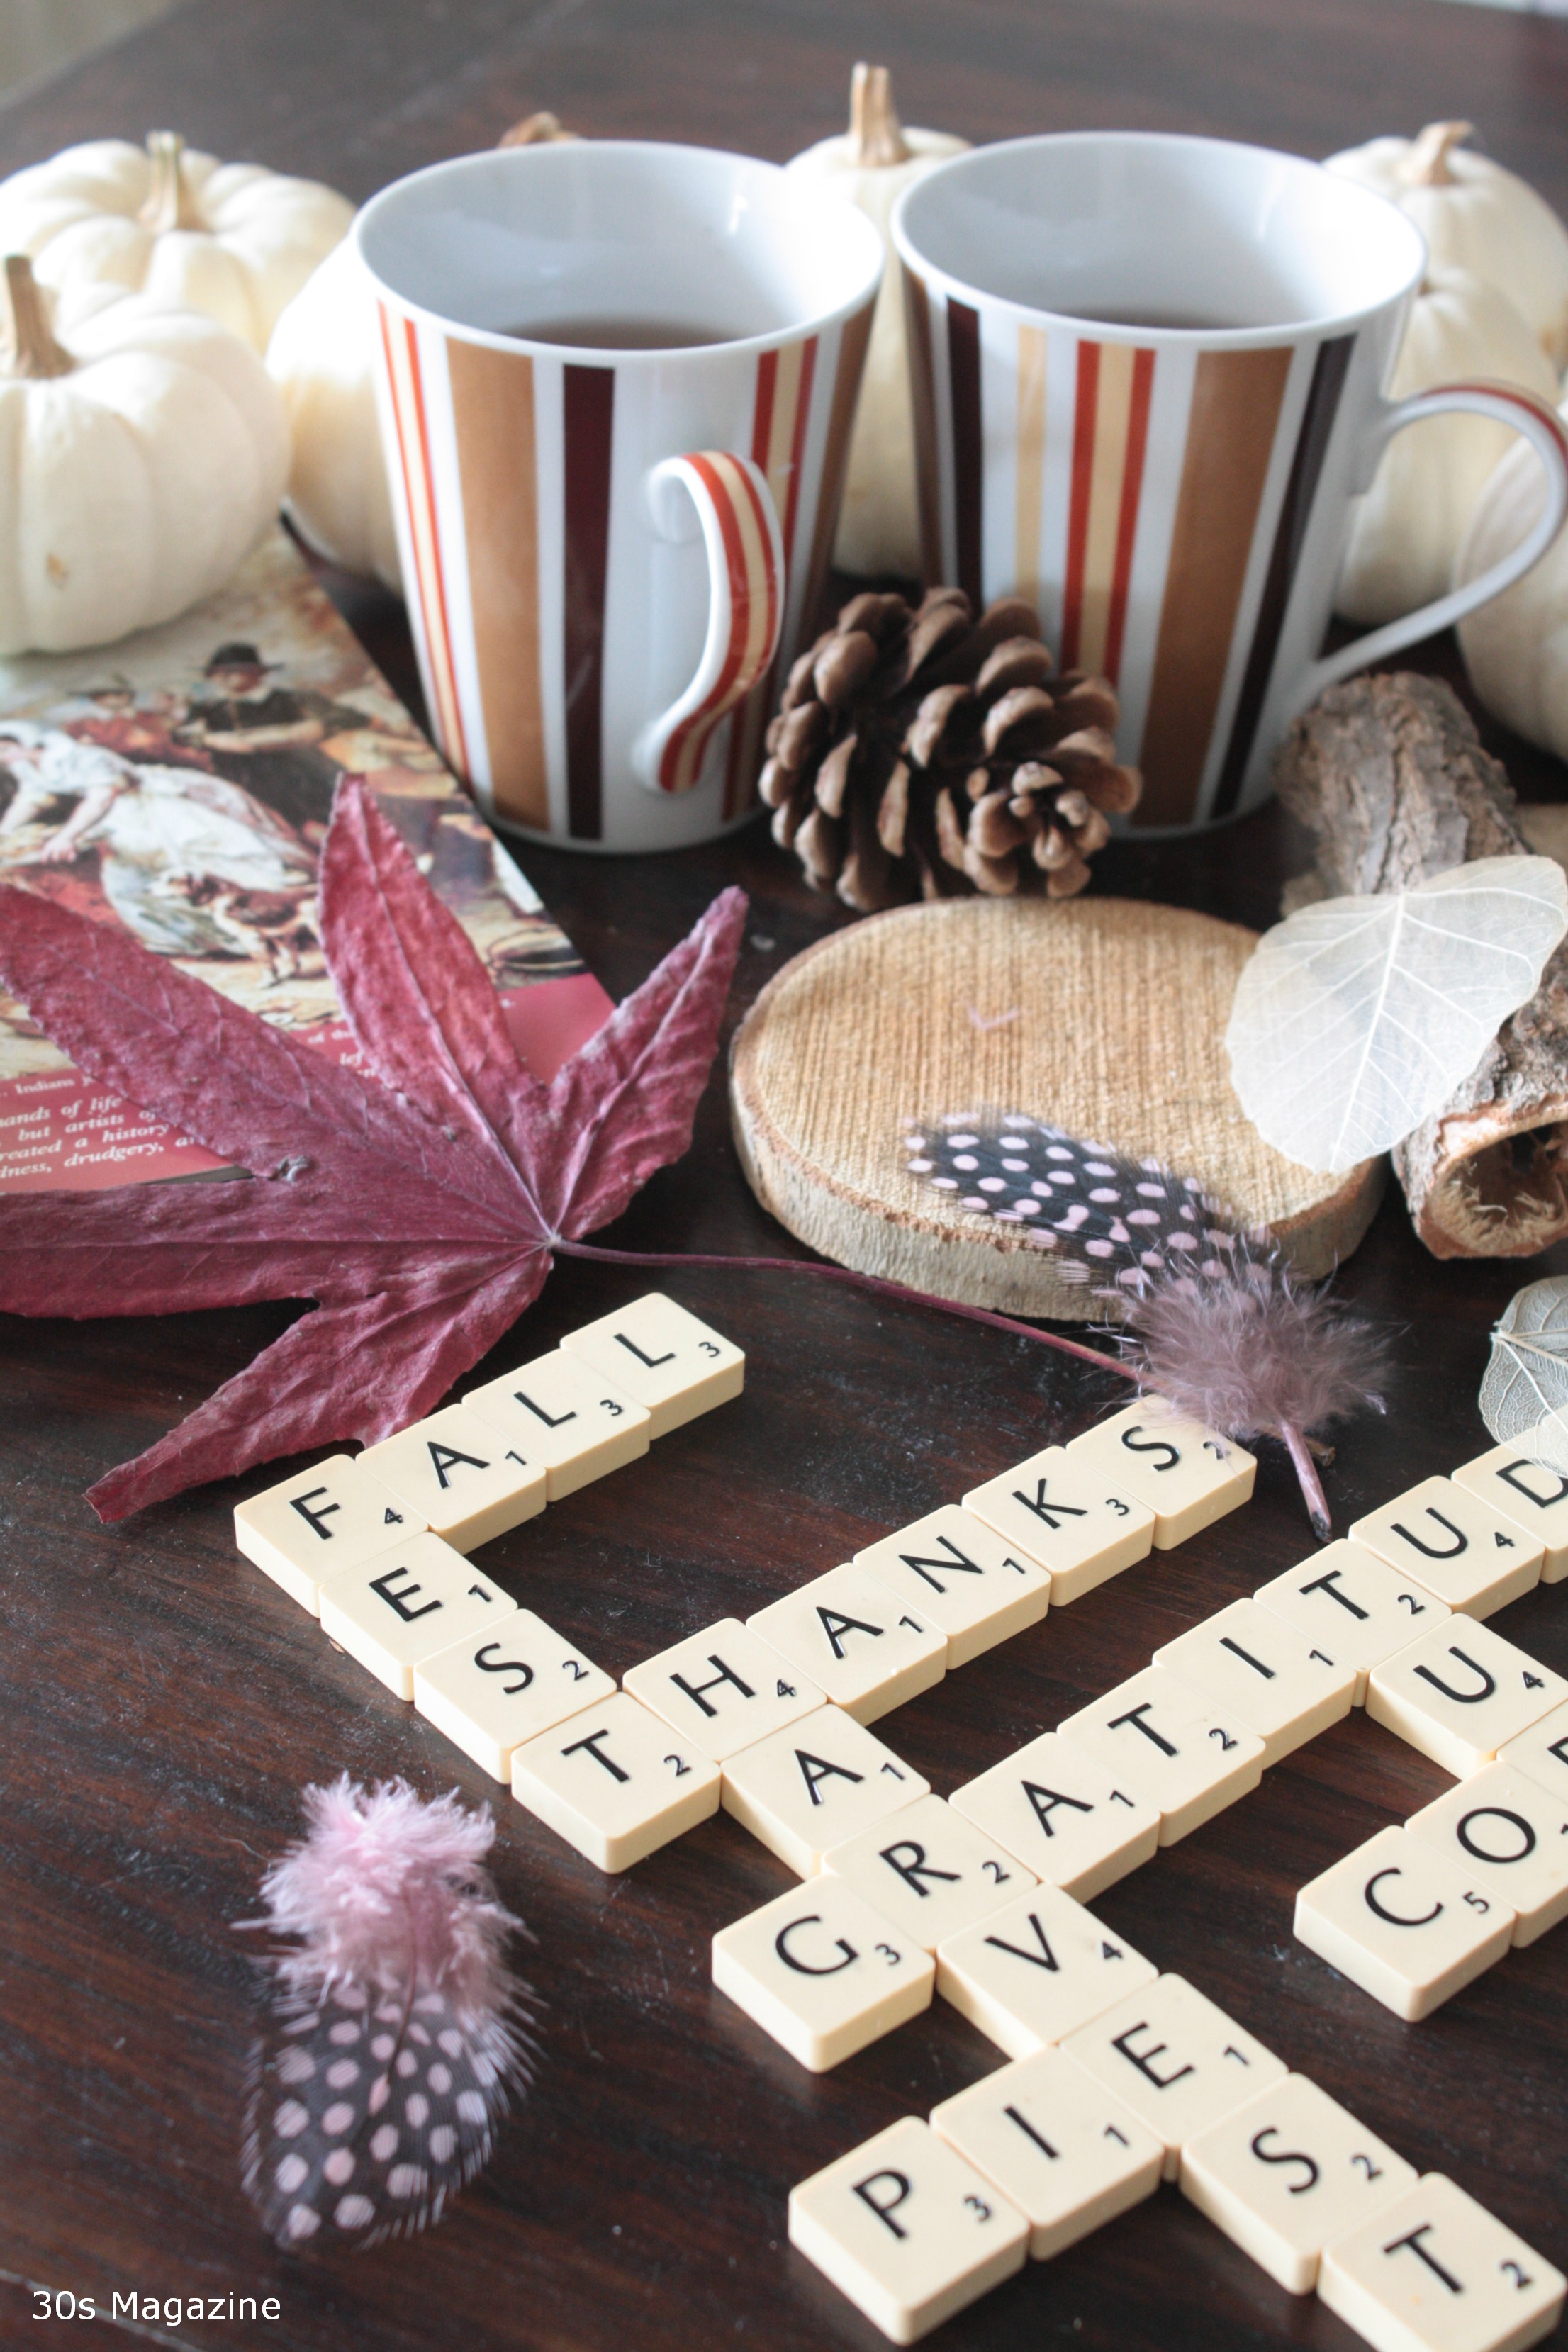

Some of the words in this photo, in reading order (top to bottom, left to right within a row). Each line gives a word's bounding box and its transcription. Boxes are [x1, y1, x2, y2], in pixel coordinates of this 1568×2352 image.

[60, 1099, 83, 1119] of
[90, 1095, 122, 1113] life
[18, 1126, 51, 1143] but
[65, 1114, 125, 1134] artists
[74, 1137, 89, 1149] a
[103, 1123, 169, 1143] history
